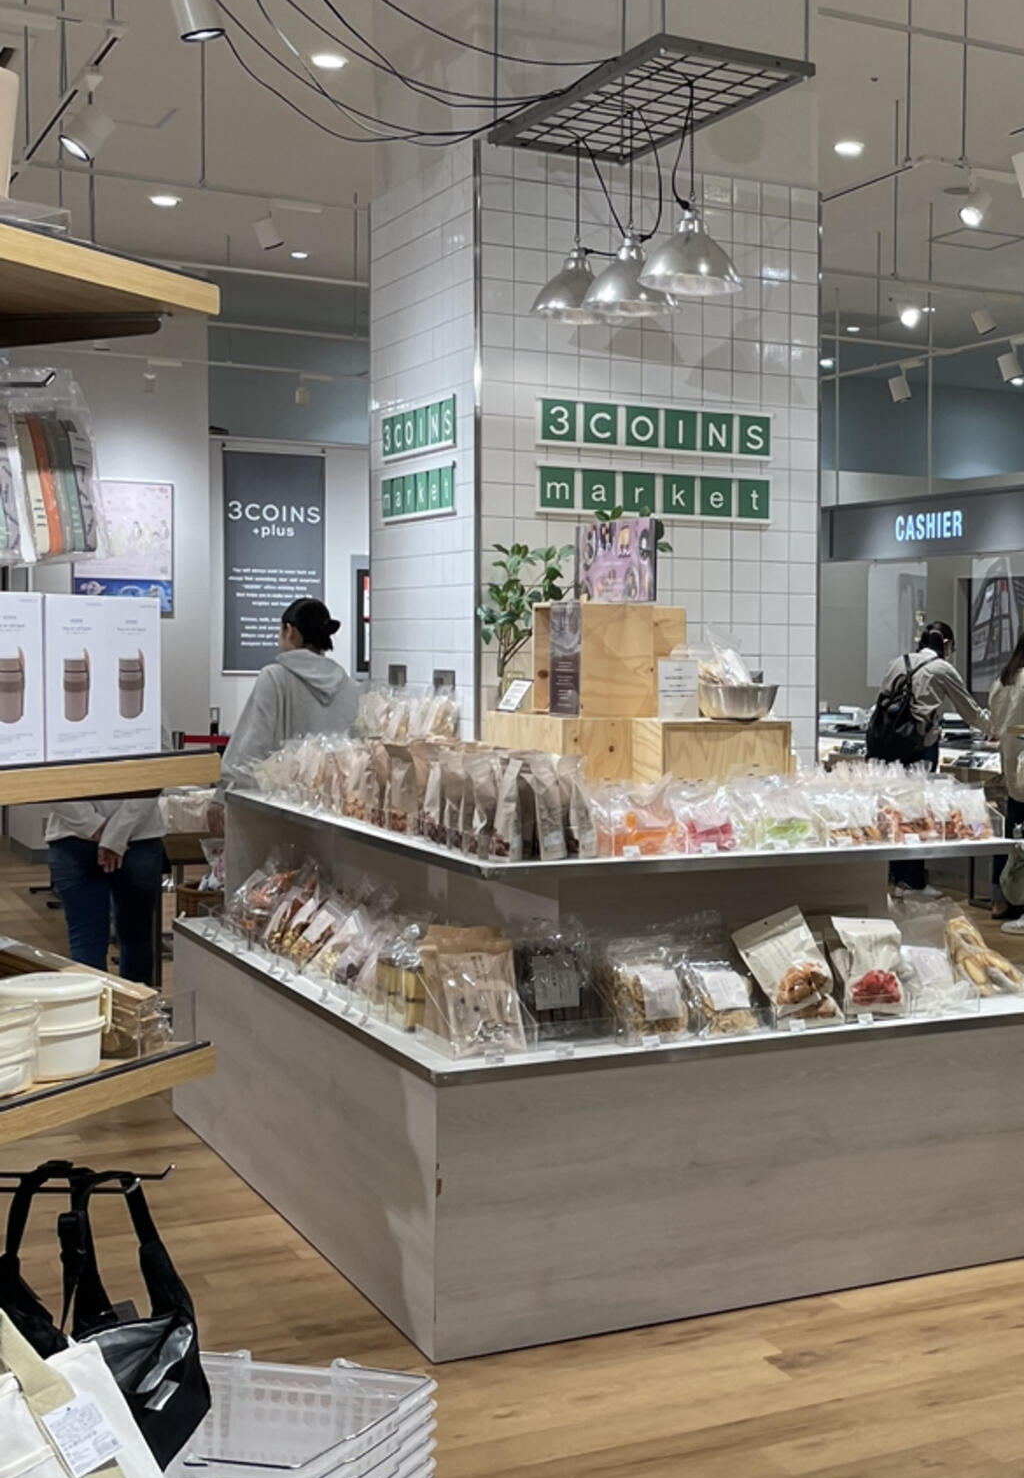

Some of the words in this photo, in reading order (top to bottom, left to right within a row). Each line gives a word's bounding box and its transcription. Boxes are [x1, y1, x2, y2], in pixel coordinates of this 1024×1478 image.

[384, 409, 452, 452] 3COINS
[549, 406, 764, 450] 3COINS
[383, 478, 450, 511] market
[546, 481, 759, 511] market
[227, 500, 321, 524] 3COINS
[895, 509, 963, 542] CASHIER
